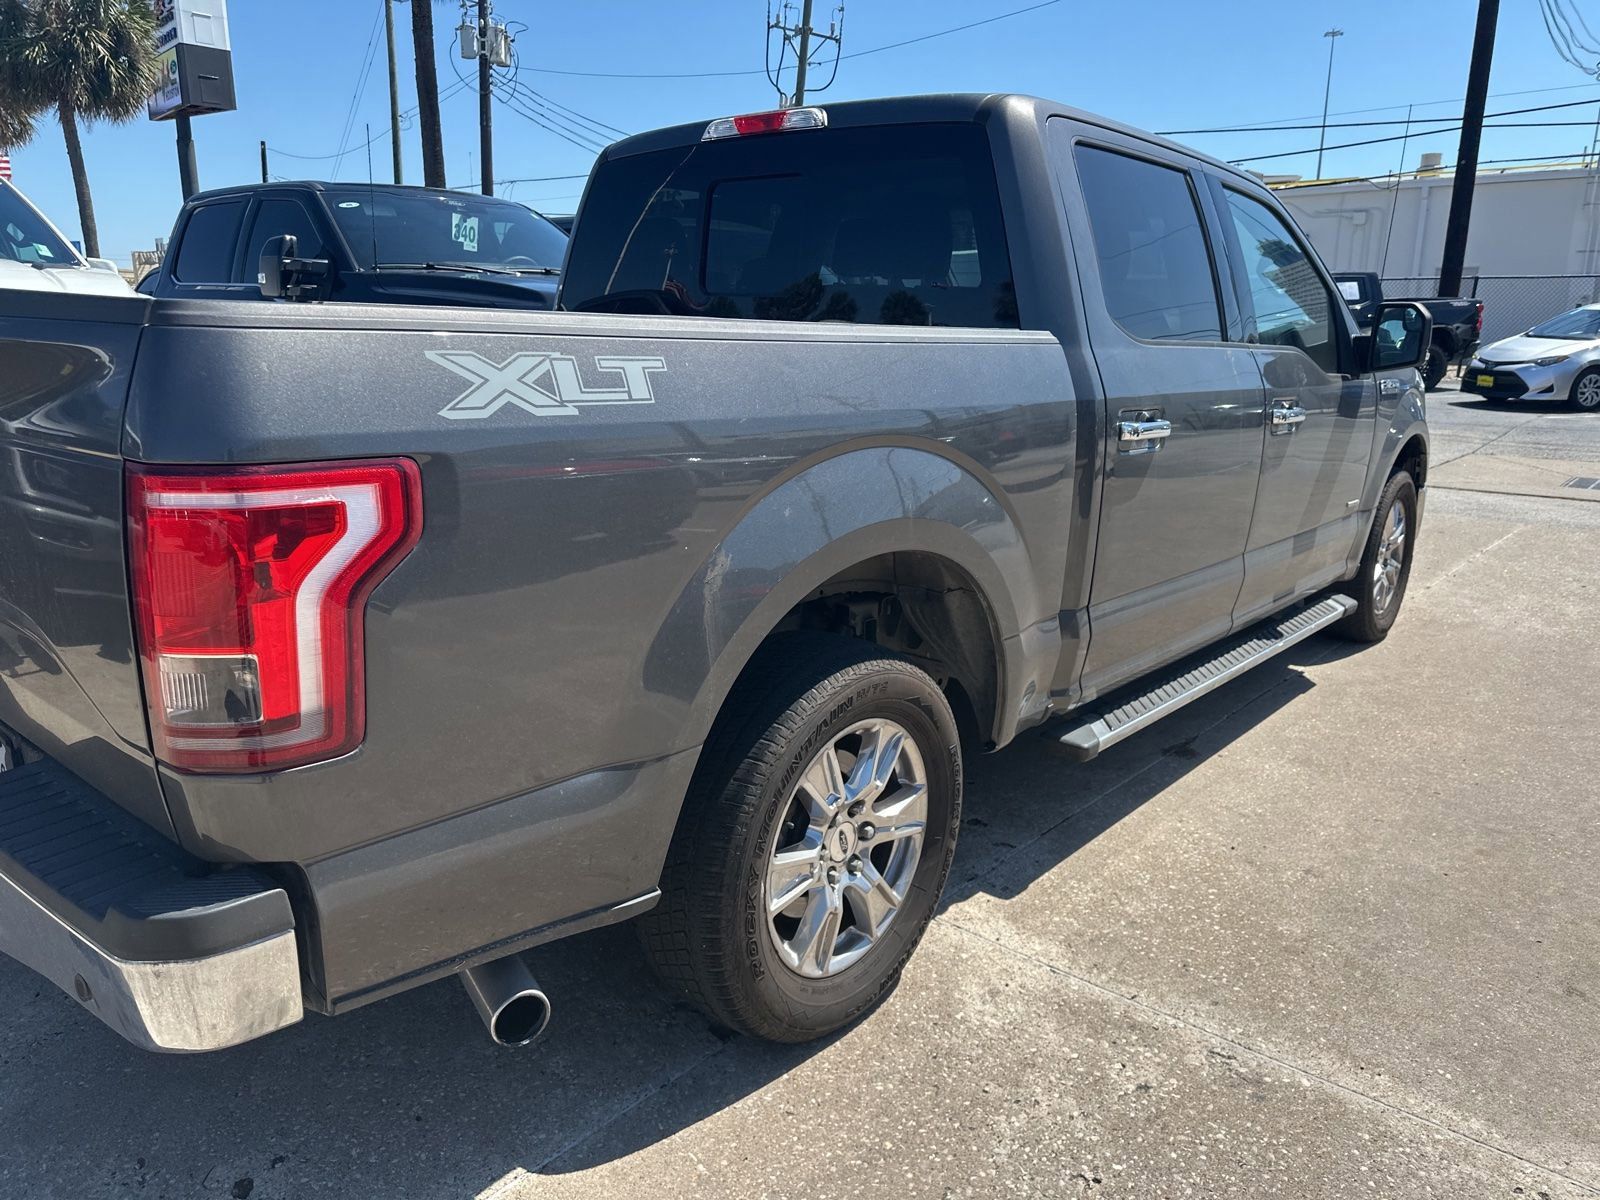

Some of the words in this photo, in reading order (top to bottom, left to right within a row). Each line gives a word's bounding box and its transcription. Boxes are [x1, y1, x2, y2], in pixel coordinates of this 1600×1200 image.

[453, 223, 476, 243] 340
[424, 350, 667, 419] XLT
[745, 863, 765, 981] ROCKY
[755, 697, 853, 858] MOUNTAIN
